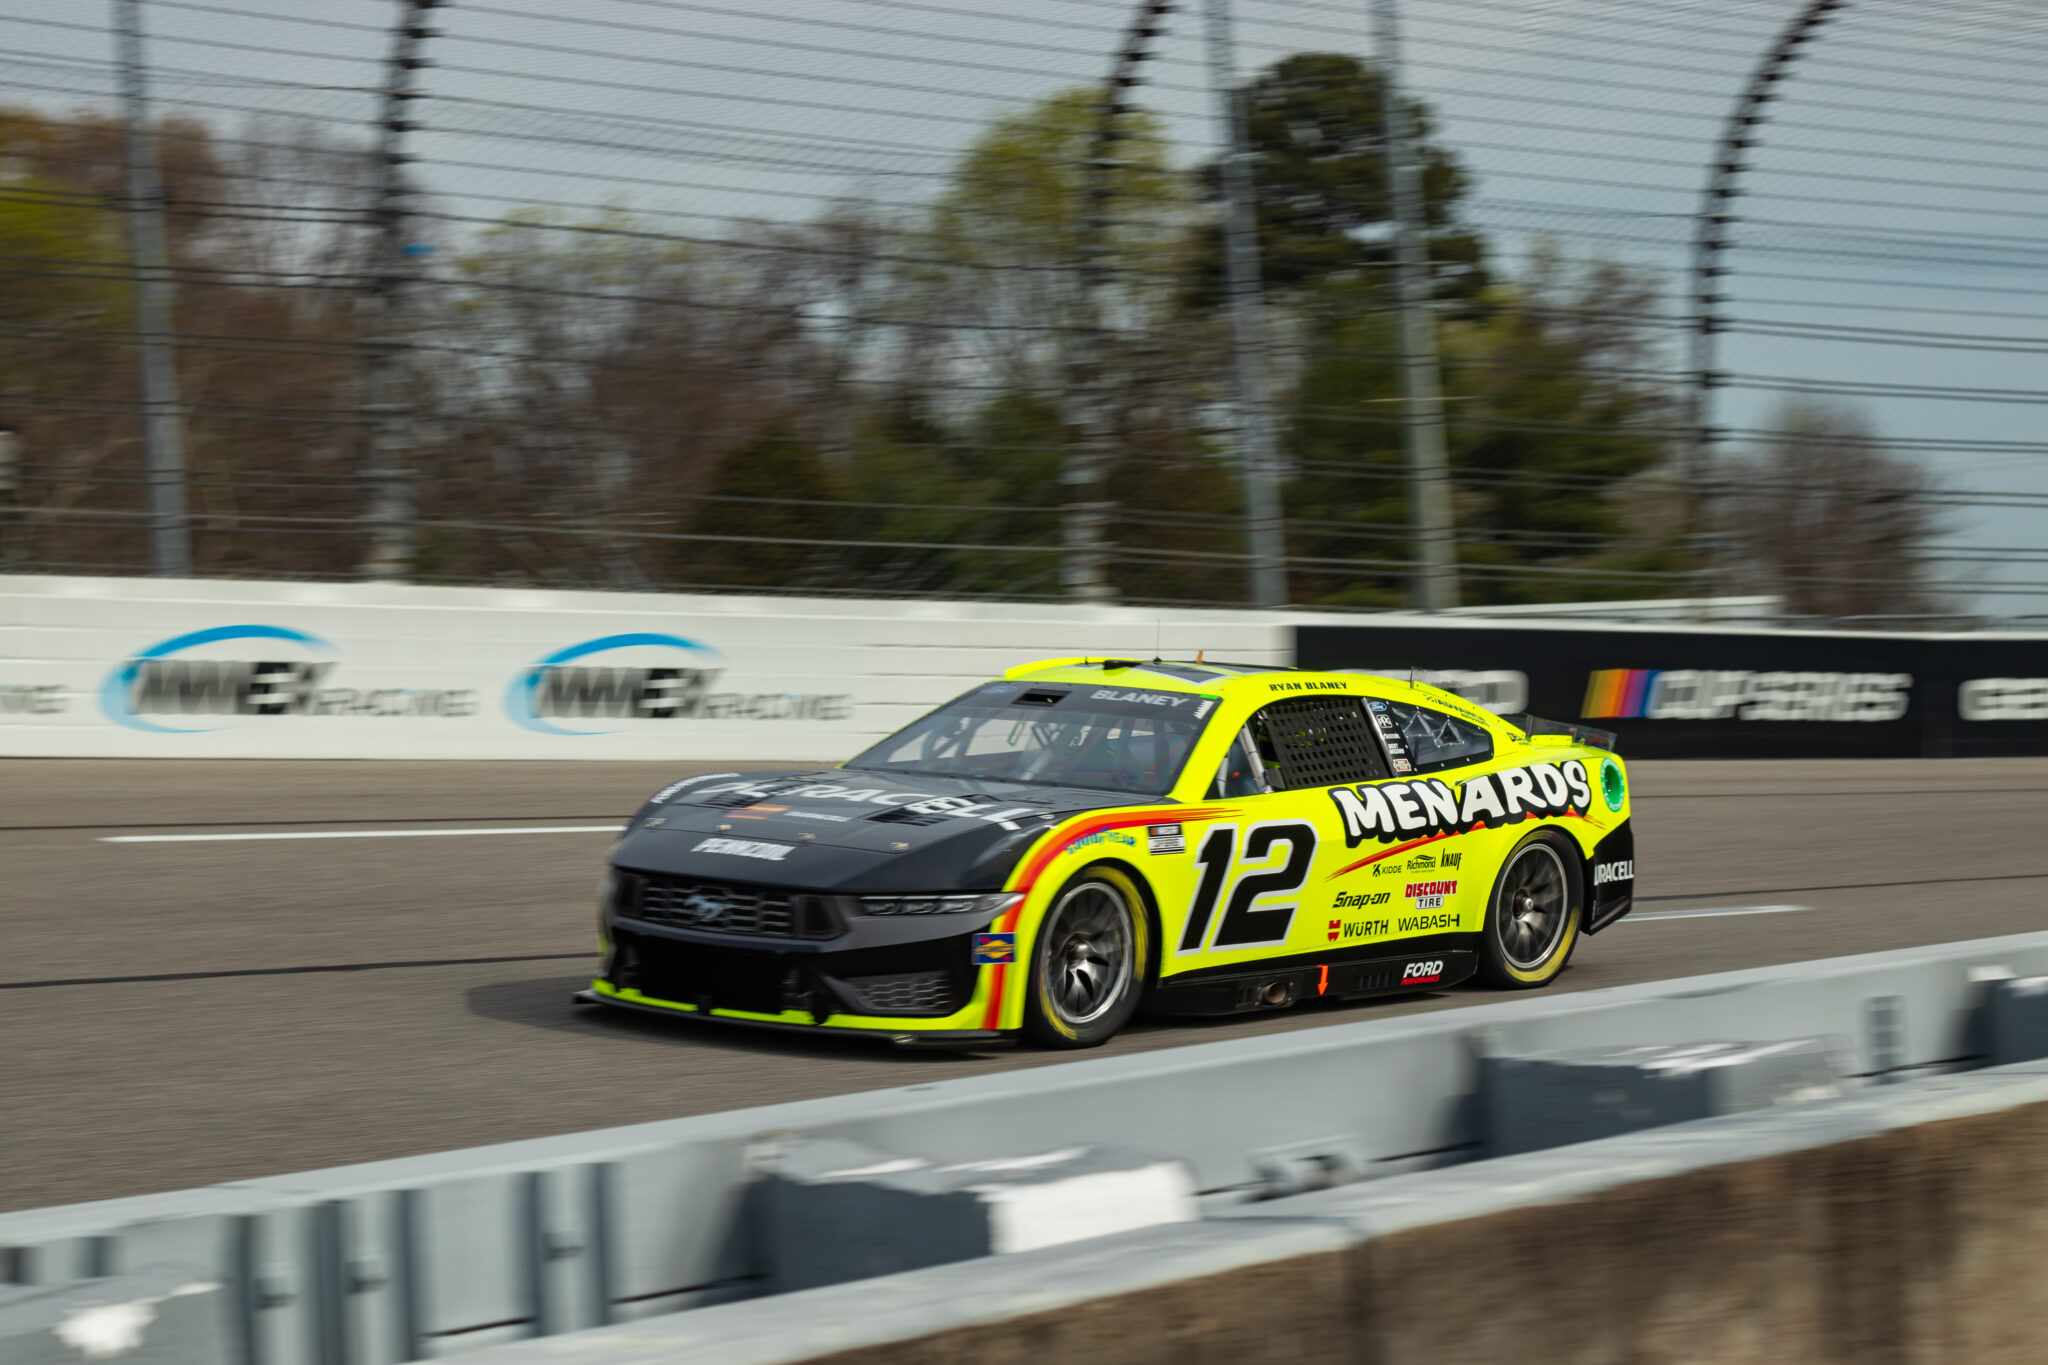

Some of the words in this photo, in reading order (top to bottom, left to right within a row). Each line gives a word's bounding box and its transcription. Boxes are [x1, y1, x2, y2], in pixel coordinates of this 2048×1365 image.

[1269, 682, 1302, 691] RYAN
[1305, 682, 1348, 690] BLANEY
[1090, 690, 1190, 707] BLANEY
[1329, 759, 1591, 842] MENARDS
[1406, 856, 1436, 870] Richmond
[1440, 848, 1462, 871] KNAUF
[1381, 865, 1402, 874] KIDDE
[1175, 820, 1319, 956] 12
[1404, 880, 1457, 898] DISCOUNT
[1332, 892, 1391, 909] Snap-on
[1418, 897, 1441, 907] TIRE
[1343, 919, 1389, 938] WÜRTH
[1398, 914, 1460, 931] WABASH
[1402, 960, 1444, 978] FORD
